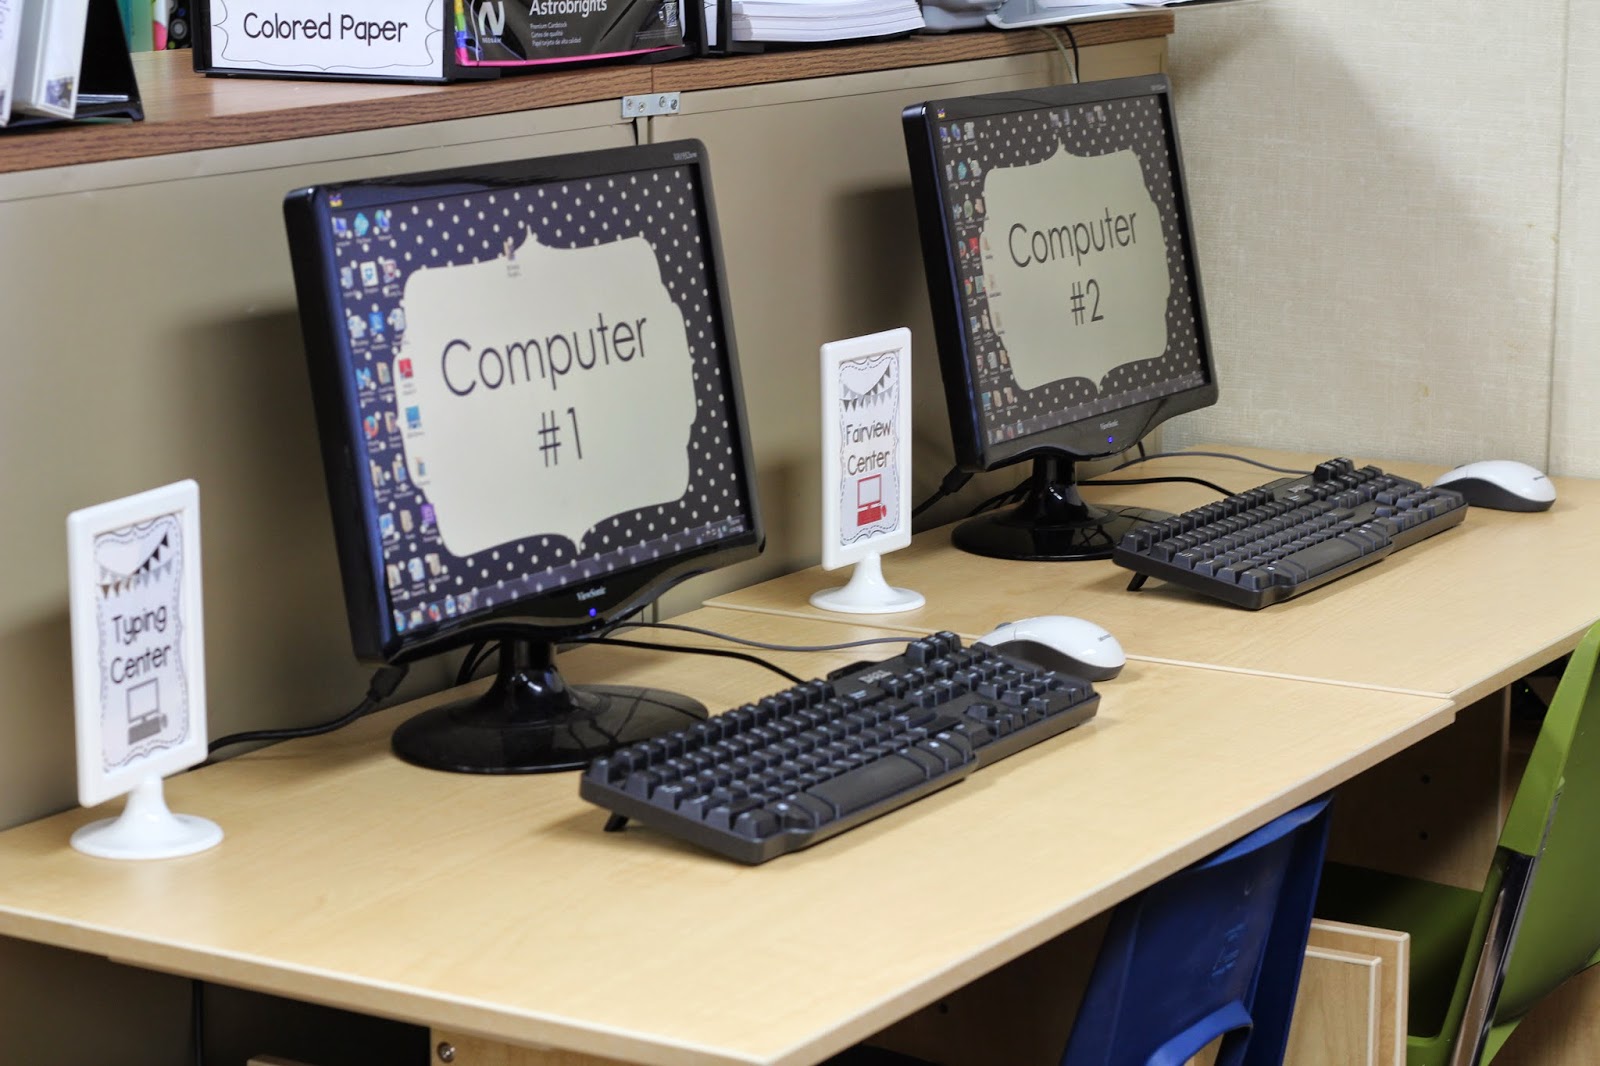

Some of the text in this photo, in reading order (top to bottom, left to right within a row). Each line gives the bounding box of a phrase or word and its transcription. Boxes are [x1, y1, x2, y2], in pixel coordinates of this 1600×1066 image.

[243, 12, 409, 46] Colored Paper
[528, 0, 608, 18] Astrobrights
[1008, 206, 1137, 268] Computer
[1070, 278, 1105, 326] #2
[441, 312, 648, 397] Computer
[537, 406, 583, 468] #1
[845, 418, 893, 446] Fairview
[847, 450, 891, 477] Center
[111, 604, 168, 646] Typing
[110, 645, 172, 685] Center
